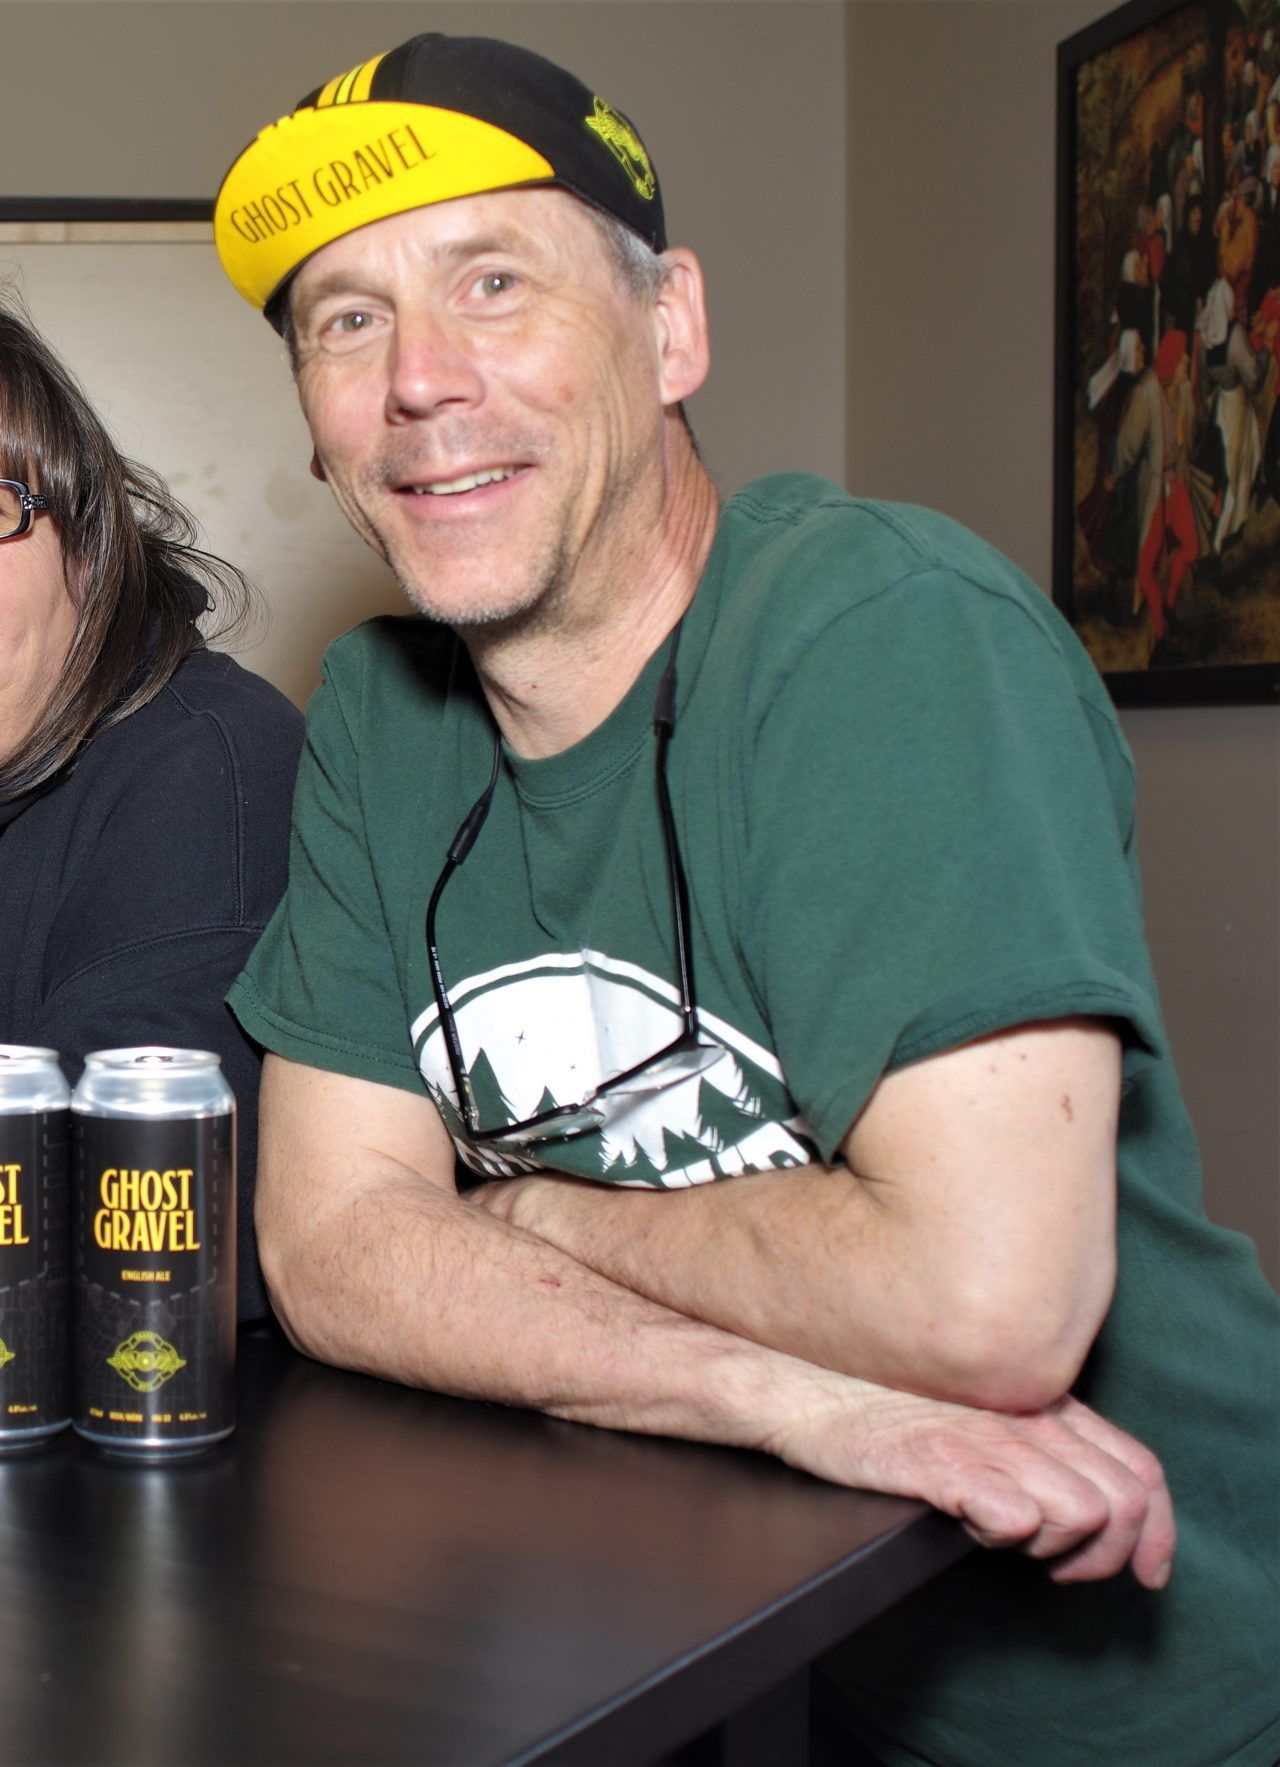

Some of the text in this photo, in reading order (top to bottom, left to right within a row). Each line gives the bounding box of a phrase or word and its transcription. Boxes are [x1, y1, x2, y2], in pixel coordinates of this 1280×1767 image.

[230, 125, 437, 243] GHOST GRAVEL
[98, 1169, 194, 1212] GHOST
[94, 1207, 200, 1252] GRAVEL
